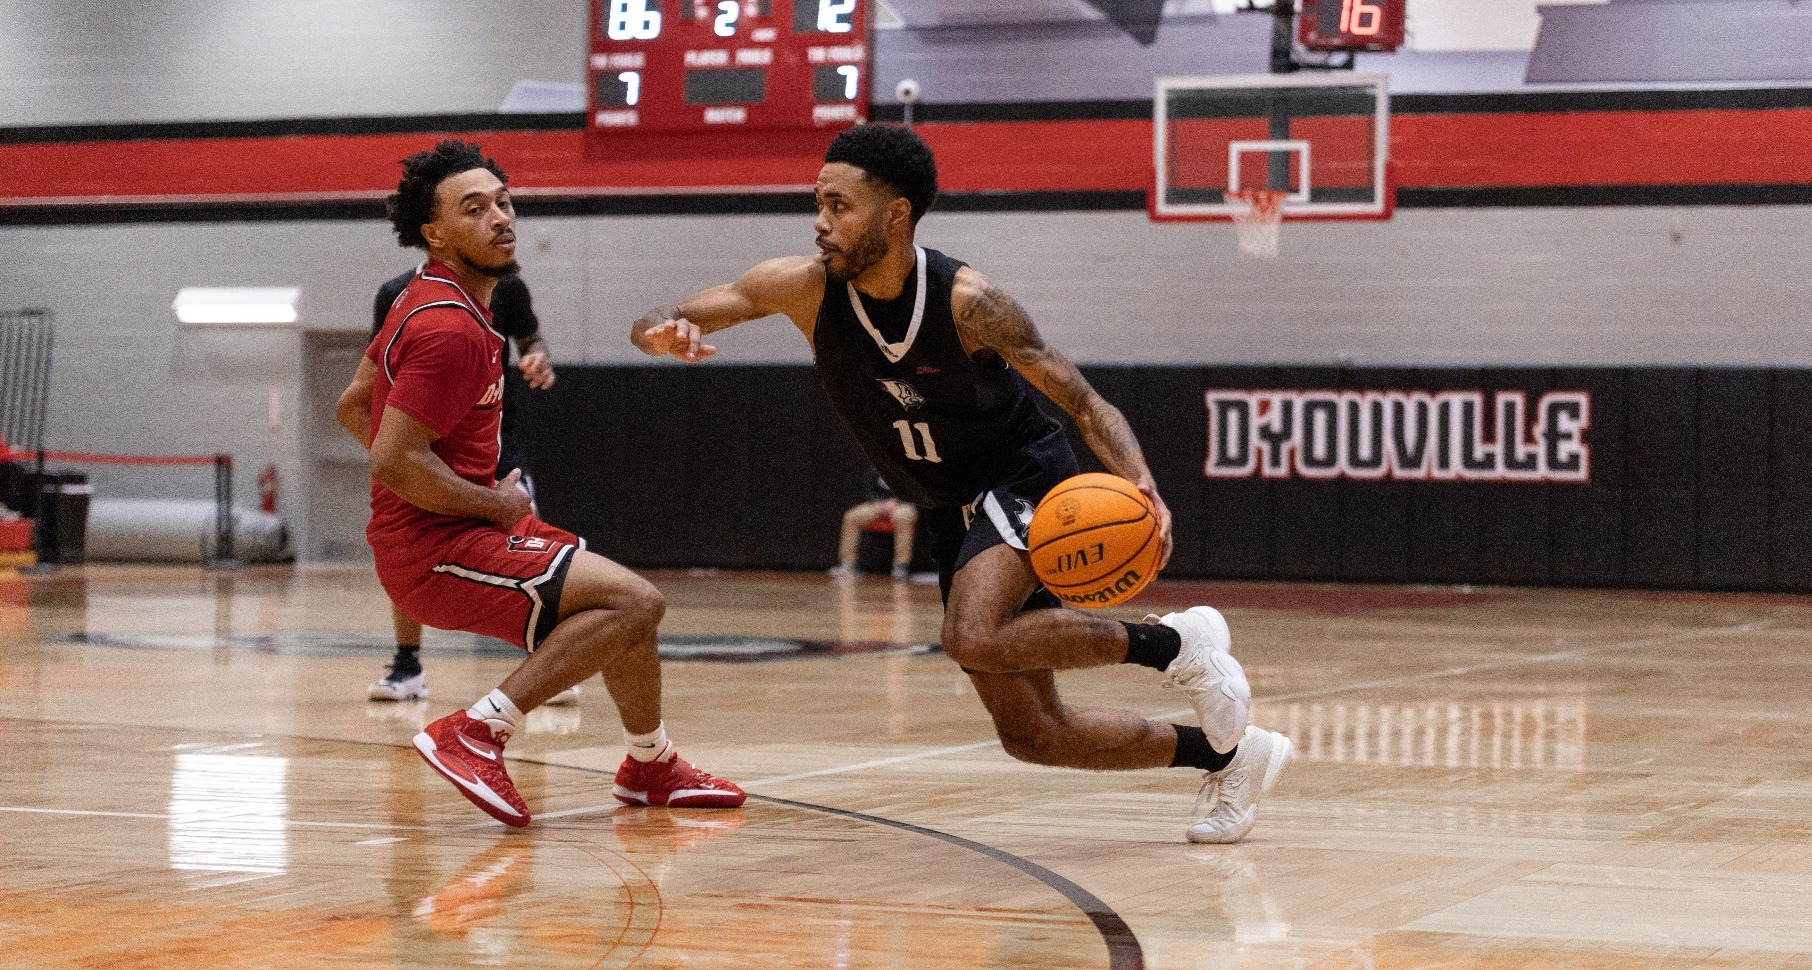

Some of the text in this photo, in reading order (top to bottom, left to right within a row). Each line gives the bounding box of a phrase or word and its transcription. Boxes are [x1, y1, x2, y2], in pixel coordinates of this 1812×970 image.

[608, 0, 661, 40] 86
[714, 1, 739, 36] 2
[817, 0, 856, 33] 12
[1340, 0, 1381, 36] 16
[618, 71, 640, 106] 7
[837, 65, 858, 99] 7
[893, 419, 942, 463] 11
[1204, 389, 1592, 482] D'YOUVILLE
[1054, 569, 1142, 603] Wilson
